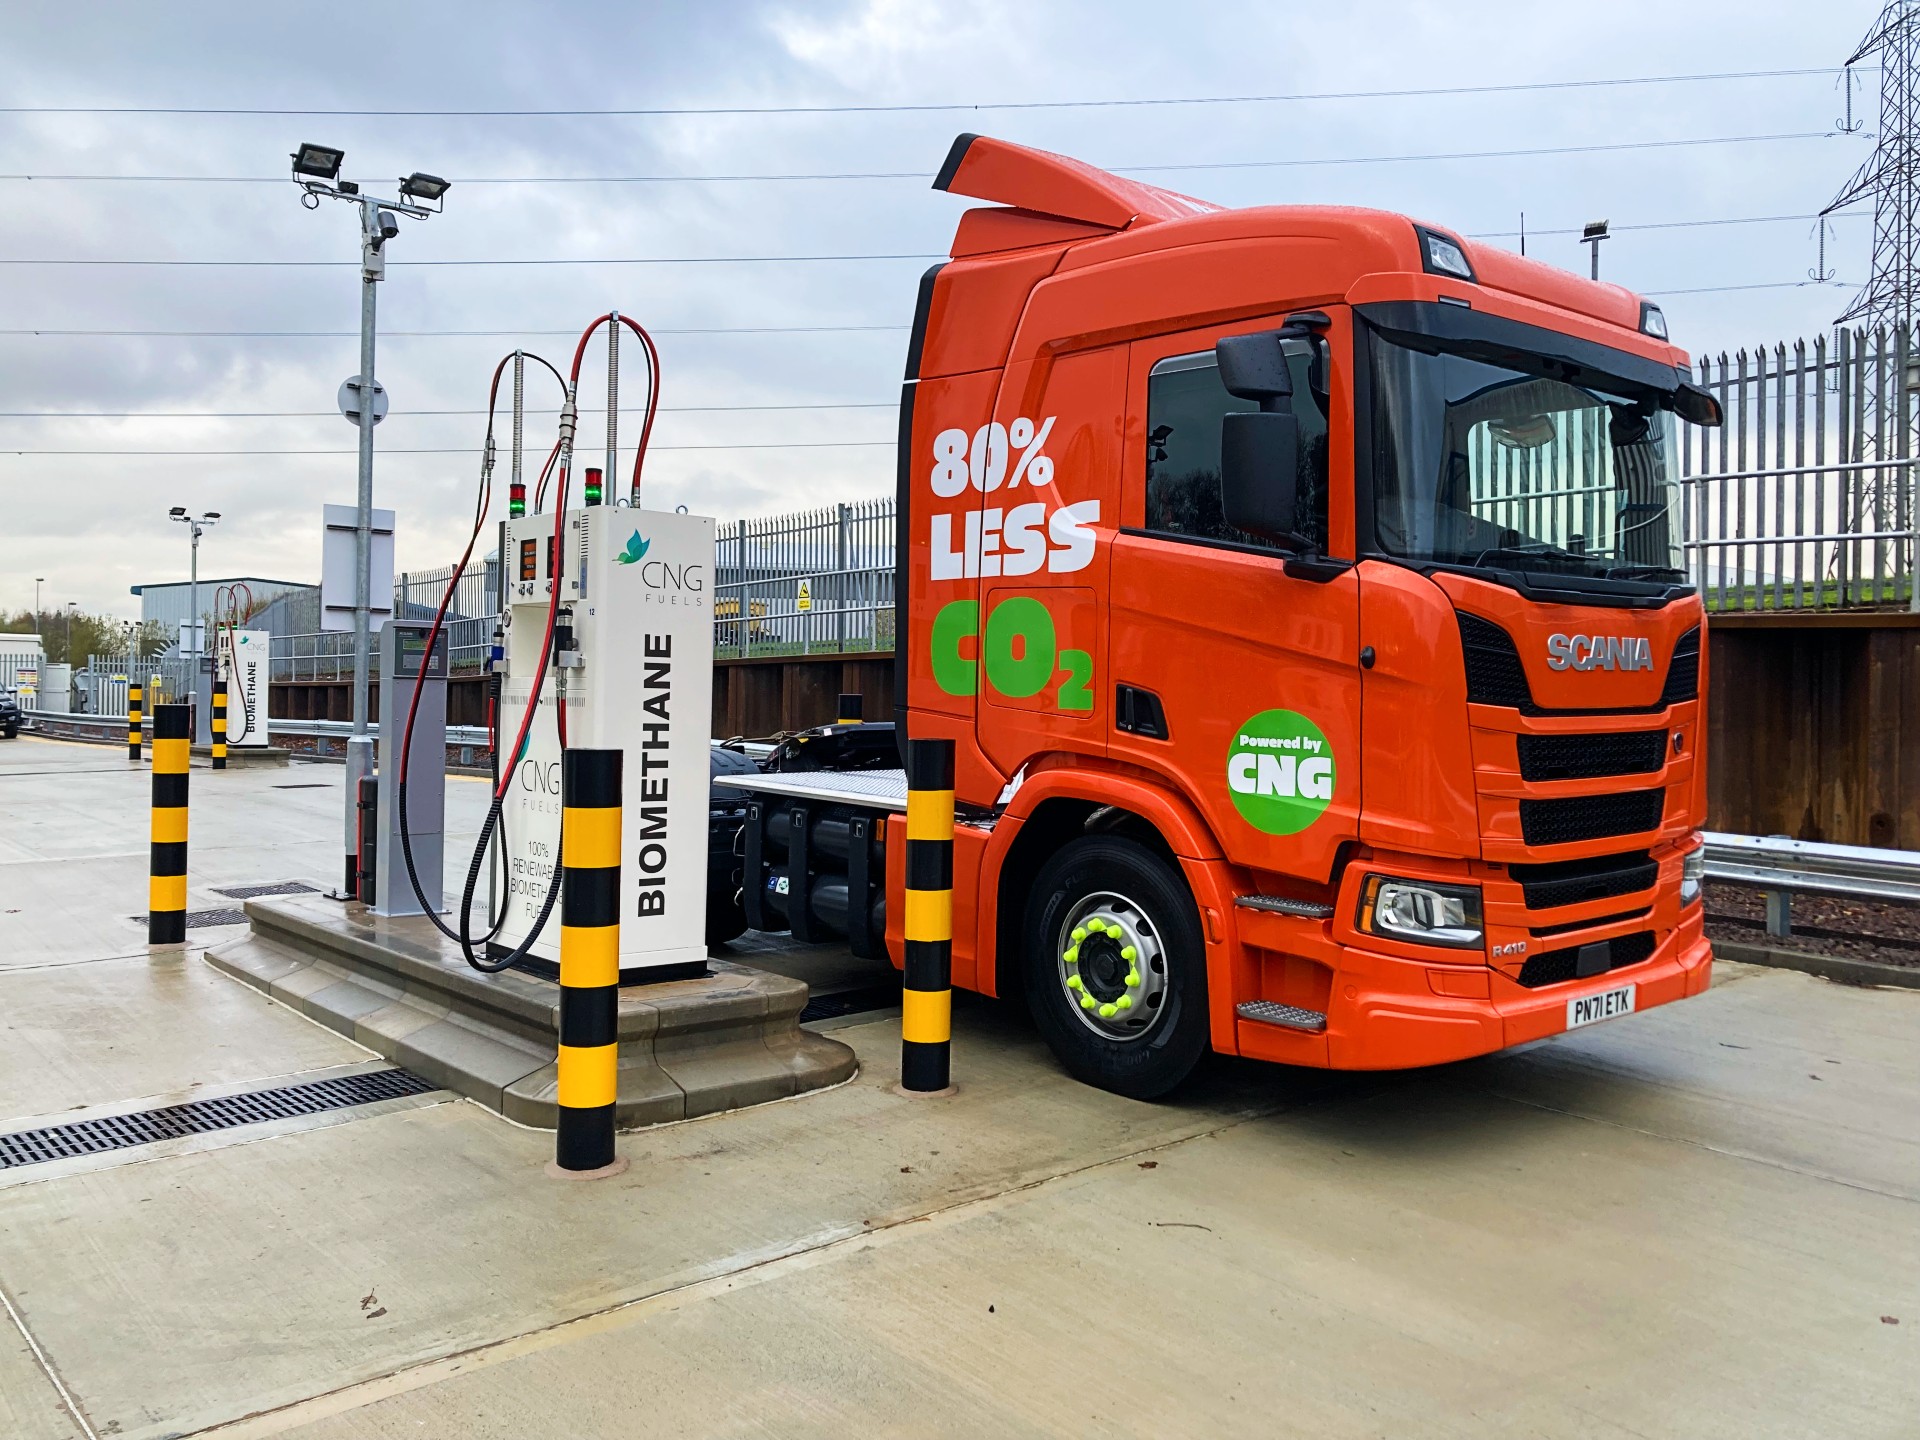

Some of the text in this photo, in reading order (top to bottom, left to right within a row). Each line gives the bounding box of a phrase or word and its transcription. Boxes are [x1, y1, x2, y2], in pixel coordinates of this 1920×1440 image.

[930, 416, 1057, 497] 80%
[930, 500, 1100, 581] LESS
[642, 562, 703, 592] CNG
[645, 593, 703, 607] FUELS
[1547, 633, 1655, 671] SCANIA
[246, 661, 257, 733] BIOMETHANE
[1239, 734, 1323, 754] Powered by
[521, 759, 561, 796] CNG
[637, 633, 672, 918] BIOMETHANE
[1227, 752, 1332, 800] CNG
[522, 798, 560, 815] FUELS
[528, 840, 549, 858] 100%
[513, 857, 553, 881] RENEWAB
[526, 902, 542, 919] FUE
